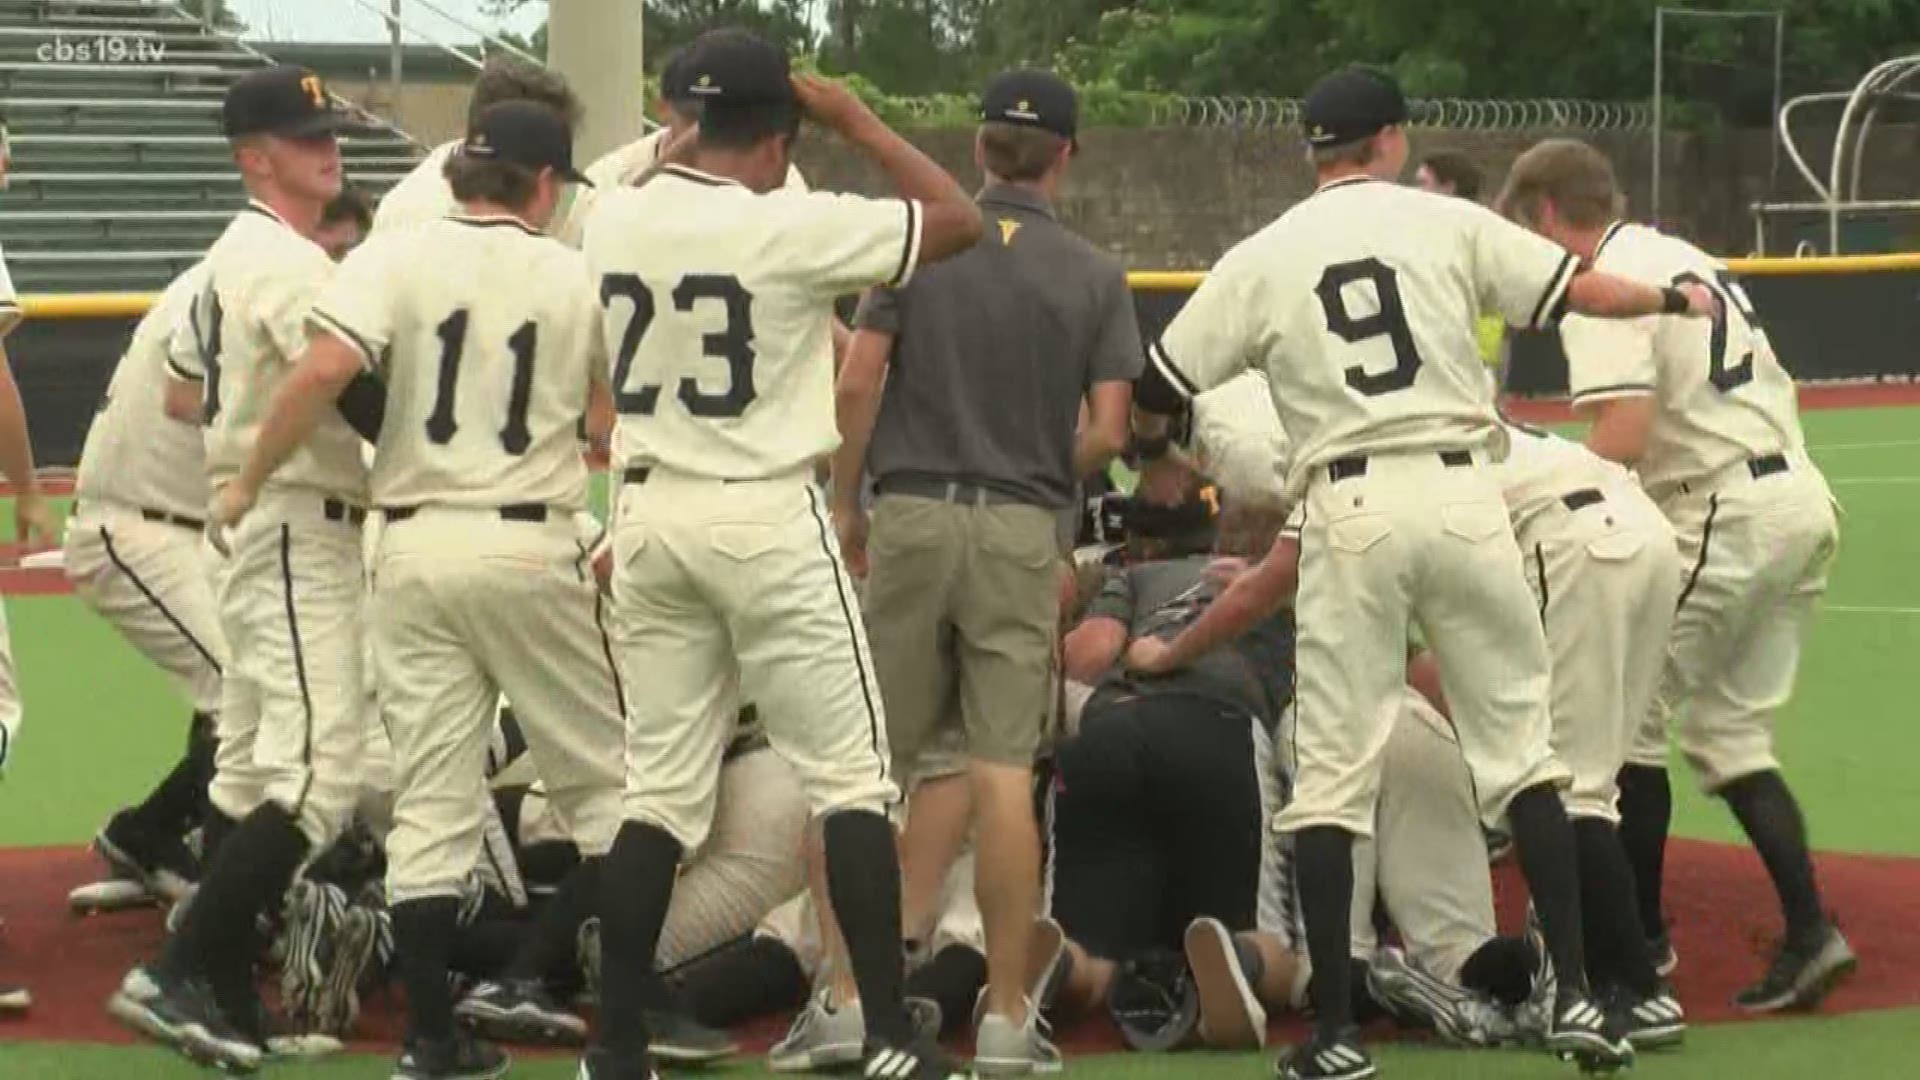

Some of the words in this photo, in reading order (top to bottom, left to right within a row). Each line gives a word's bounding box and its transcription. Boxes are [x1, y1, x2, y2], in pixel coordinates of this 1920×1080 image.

[425, 309, 537, 456] 11
[600, 273, 757, 417] 23
[1314, 257, 1423, 397] 9
